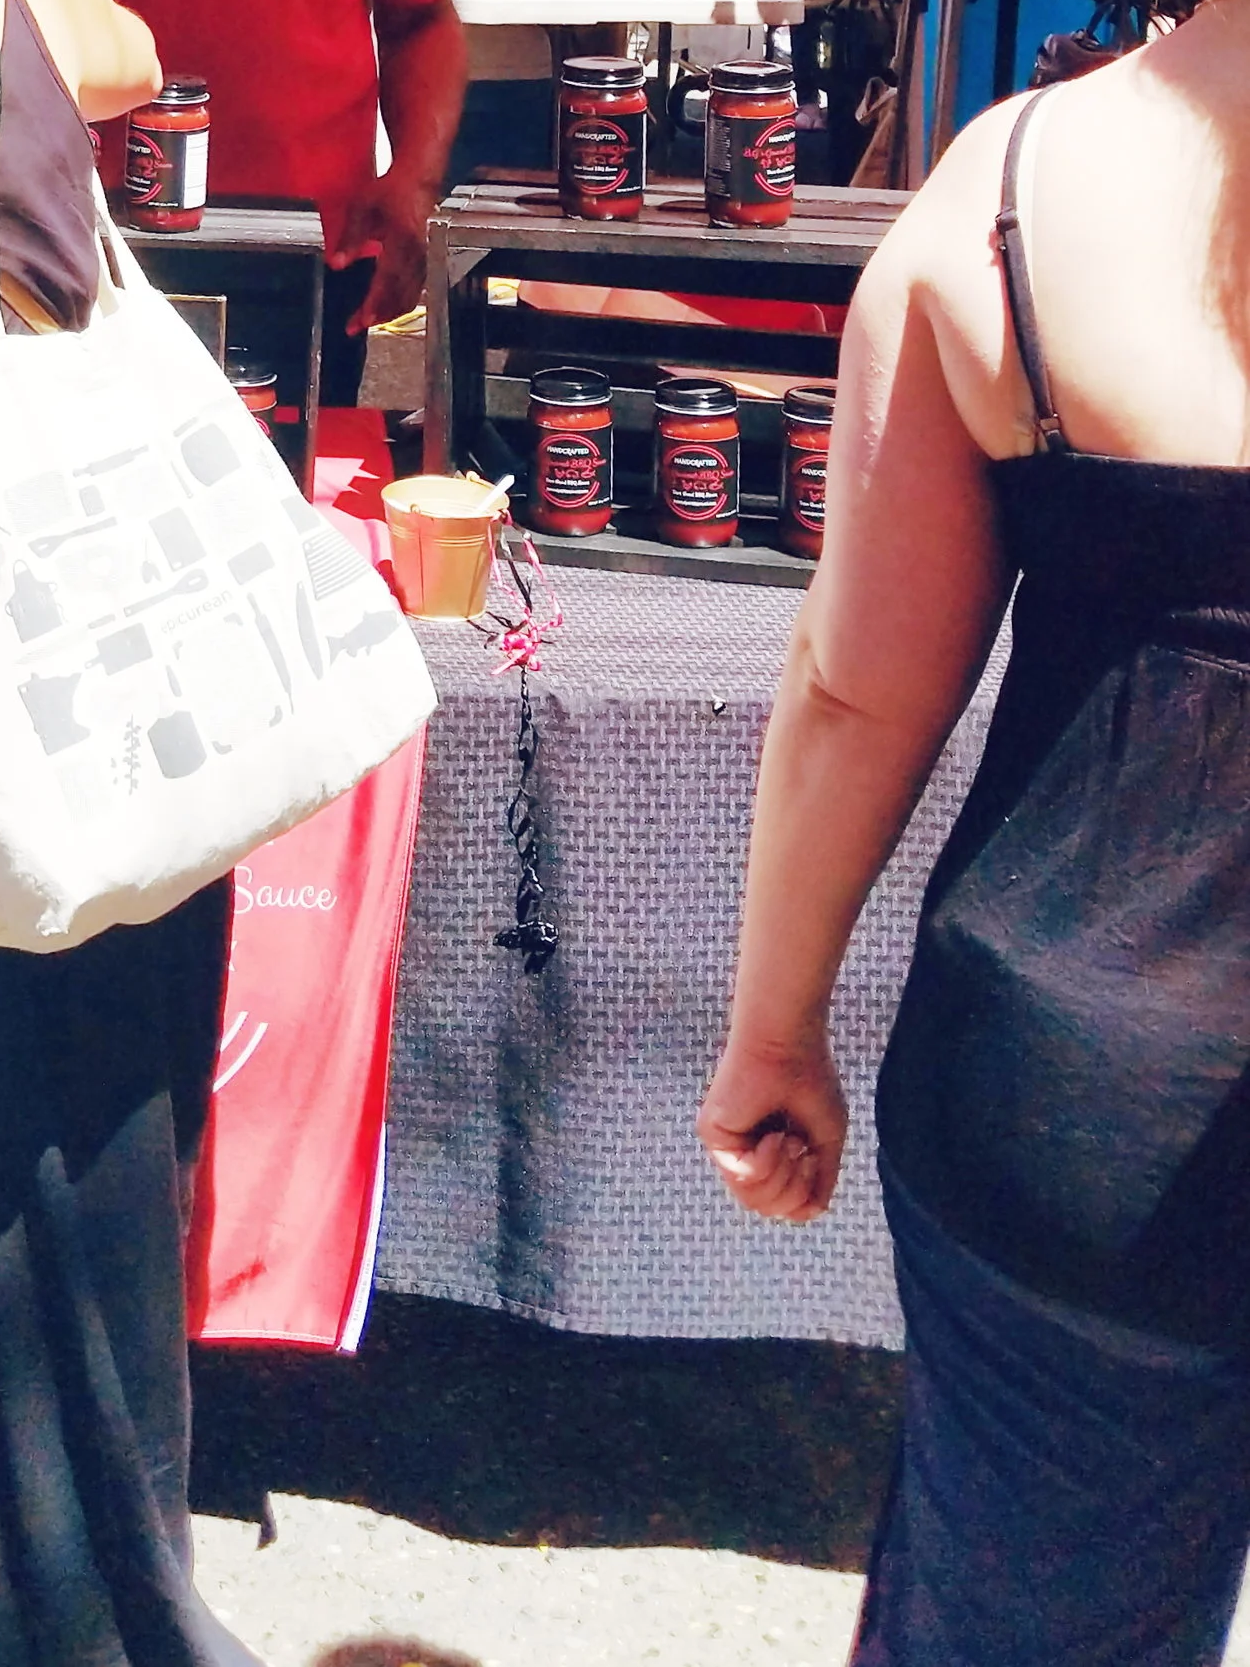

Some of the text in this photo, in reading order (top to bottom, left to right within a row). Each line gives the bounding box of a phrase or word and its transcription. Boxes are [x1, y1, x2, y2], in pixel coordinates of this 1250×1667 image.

[547, 445, 590, 456] HANDCRAFTED
[674, 457, 718, 468] HANDCRAFTED
[161, 590, 232, 634] epicurean
[234, 865, 338, 914] Sauce
